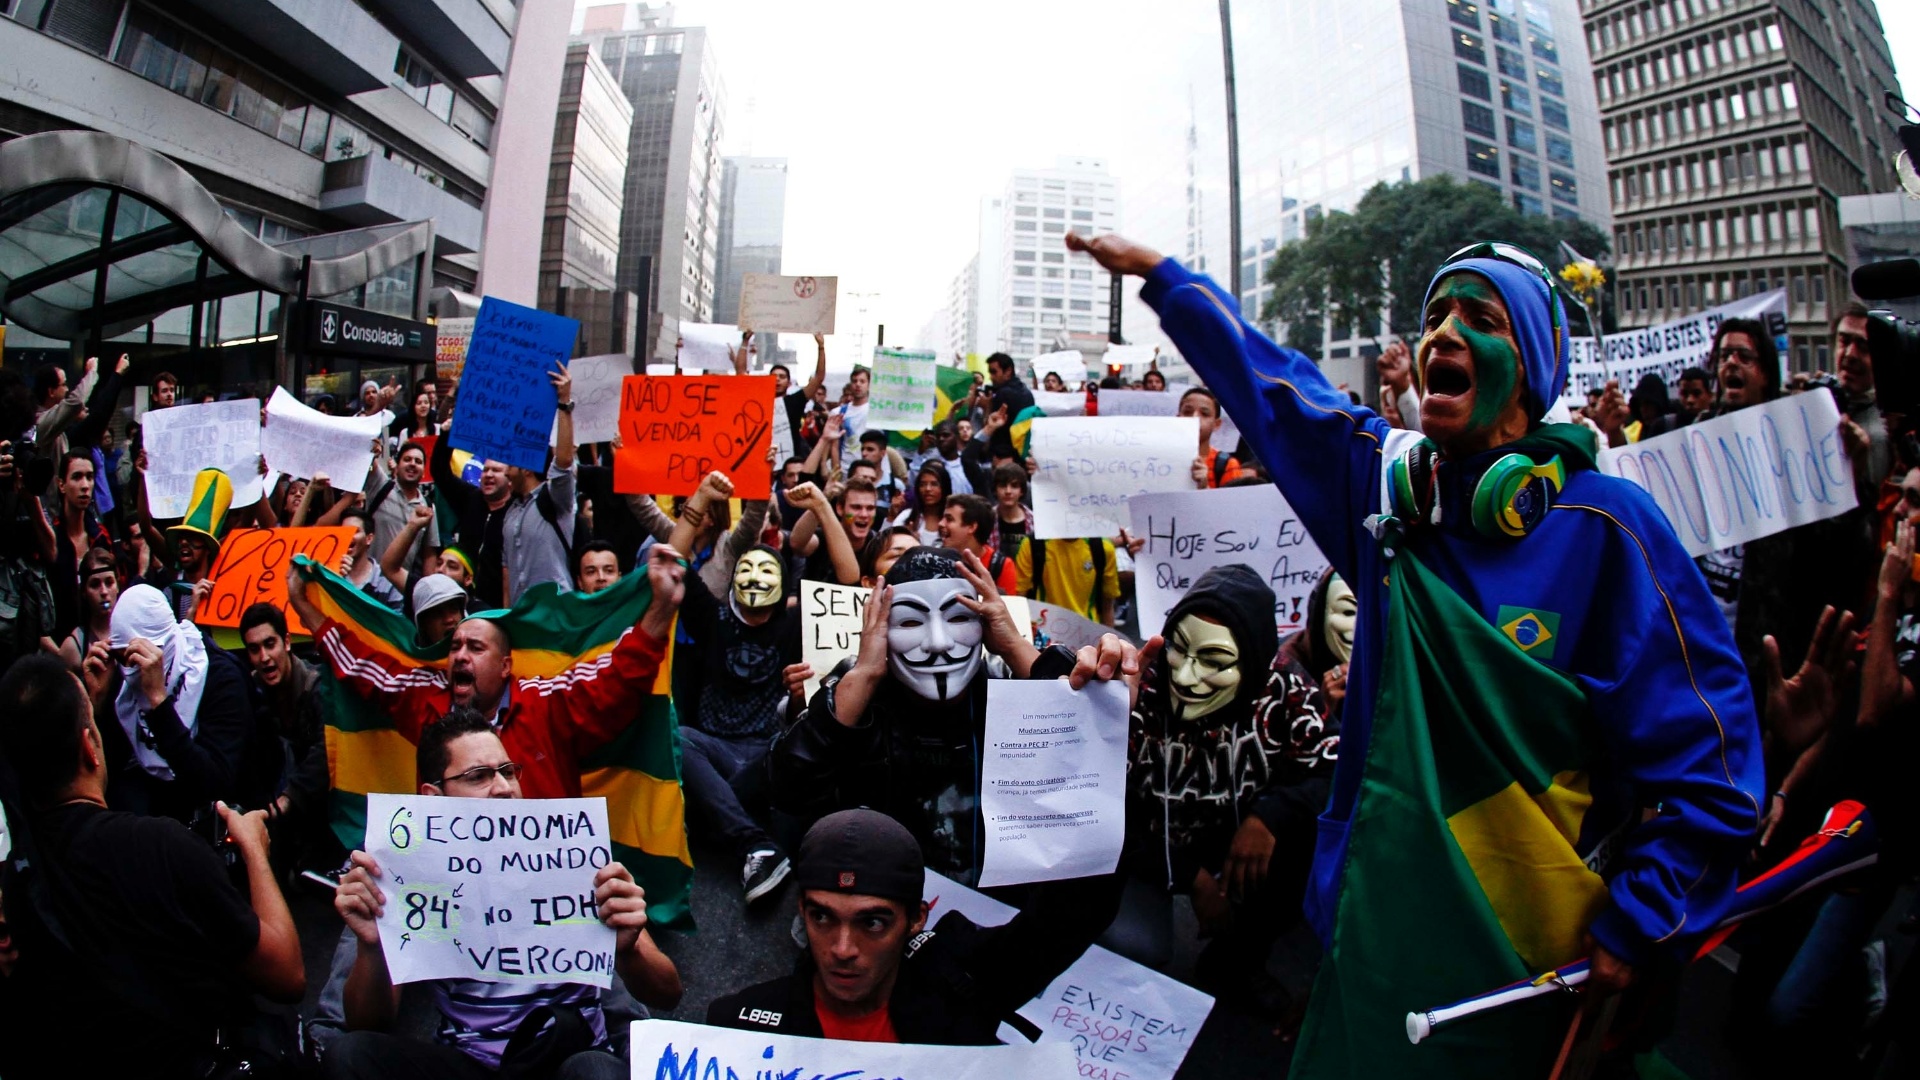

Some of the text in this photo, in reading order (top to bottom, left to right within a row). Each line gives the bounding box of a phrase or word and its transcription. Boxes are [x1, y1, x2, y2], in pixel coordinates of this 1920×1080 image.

[625, 376, 672, 413] NÃO
[680, 382, 721, 419] SE
[632, 420, 702, 443] VENDA
[667, 453, 713, 484] POR
[1066, 456, 1172, 479] EDUCAÇÃO
[1022, 713, 1034, 721] Um
[1035, 712, 1067, 720] movimento
[1018, 727, 1050, 735] Mudanças
[999, 751, 1036, 760] impunidade
[1000, 741, 1022, 749] Contra
[1028, 741, 1041, 749] PEC
[998, 779, 1010, 787] Fim
[1029, 787, 1047, 796] temos
[1026, 821, 1043, 829] saber
[448, 846, 611, 876] DO MUNDO
[530, 890, 600, 927] IDH
[738, 1006, 783, 1027] L899
[1060, 984, 1186, 1043] EXISTEM
[1051, 1005, 1149, 1054] PESSOAS
